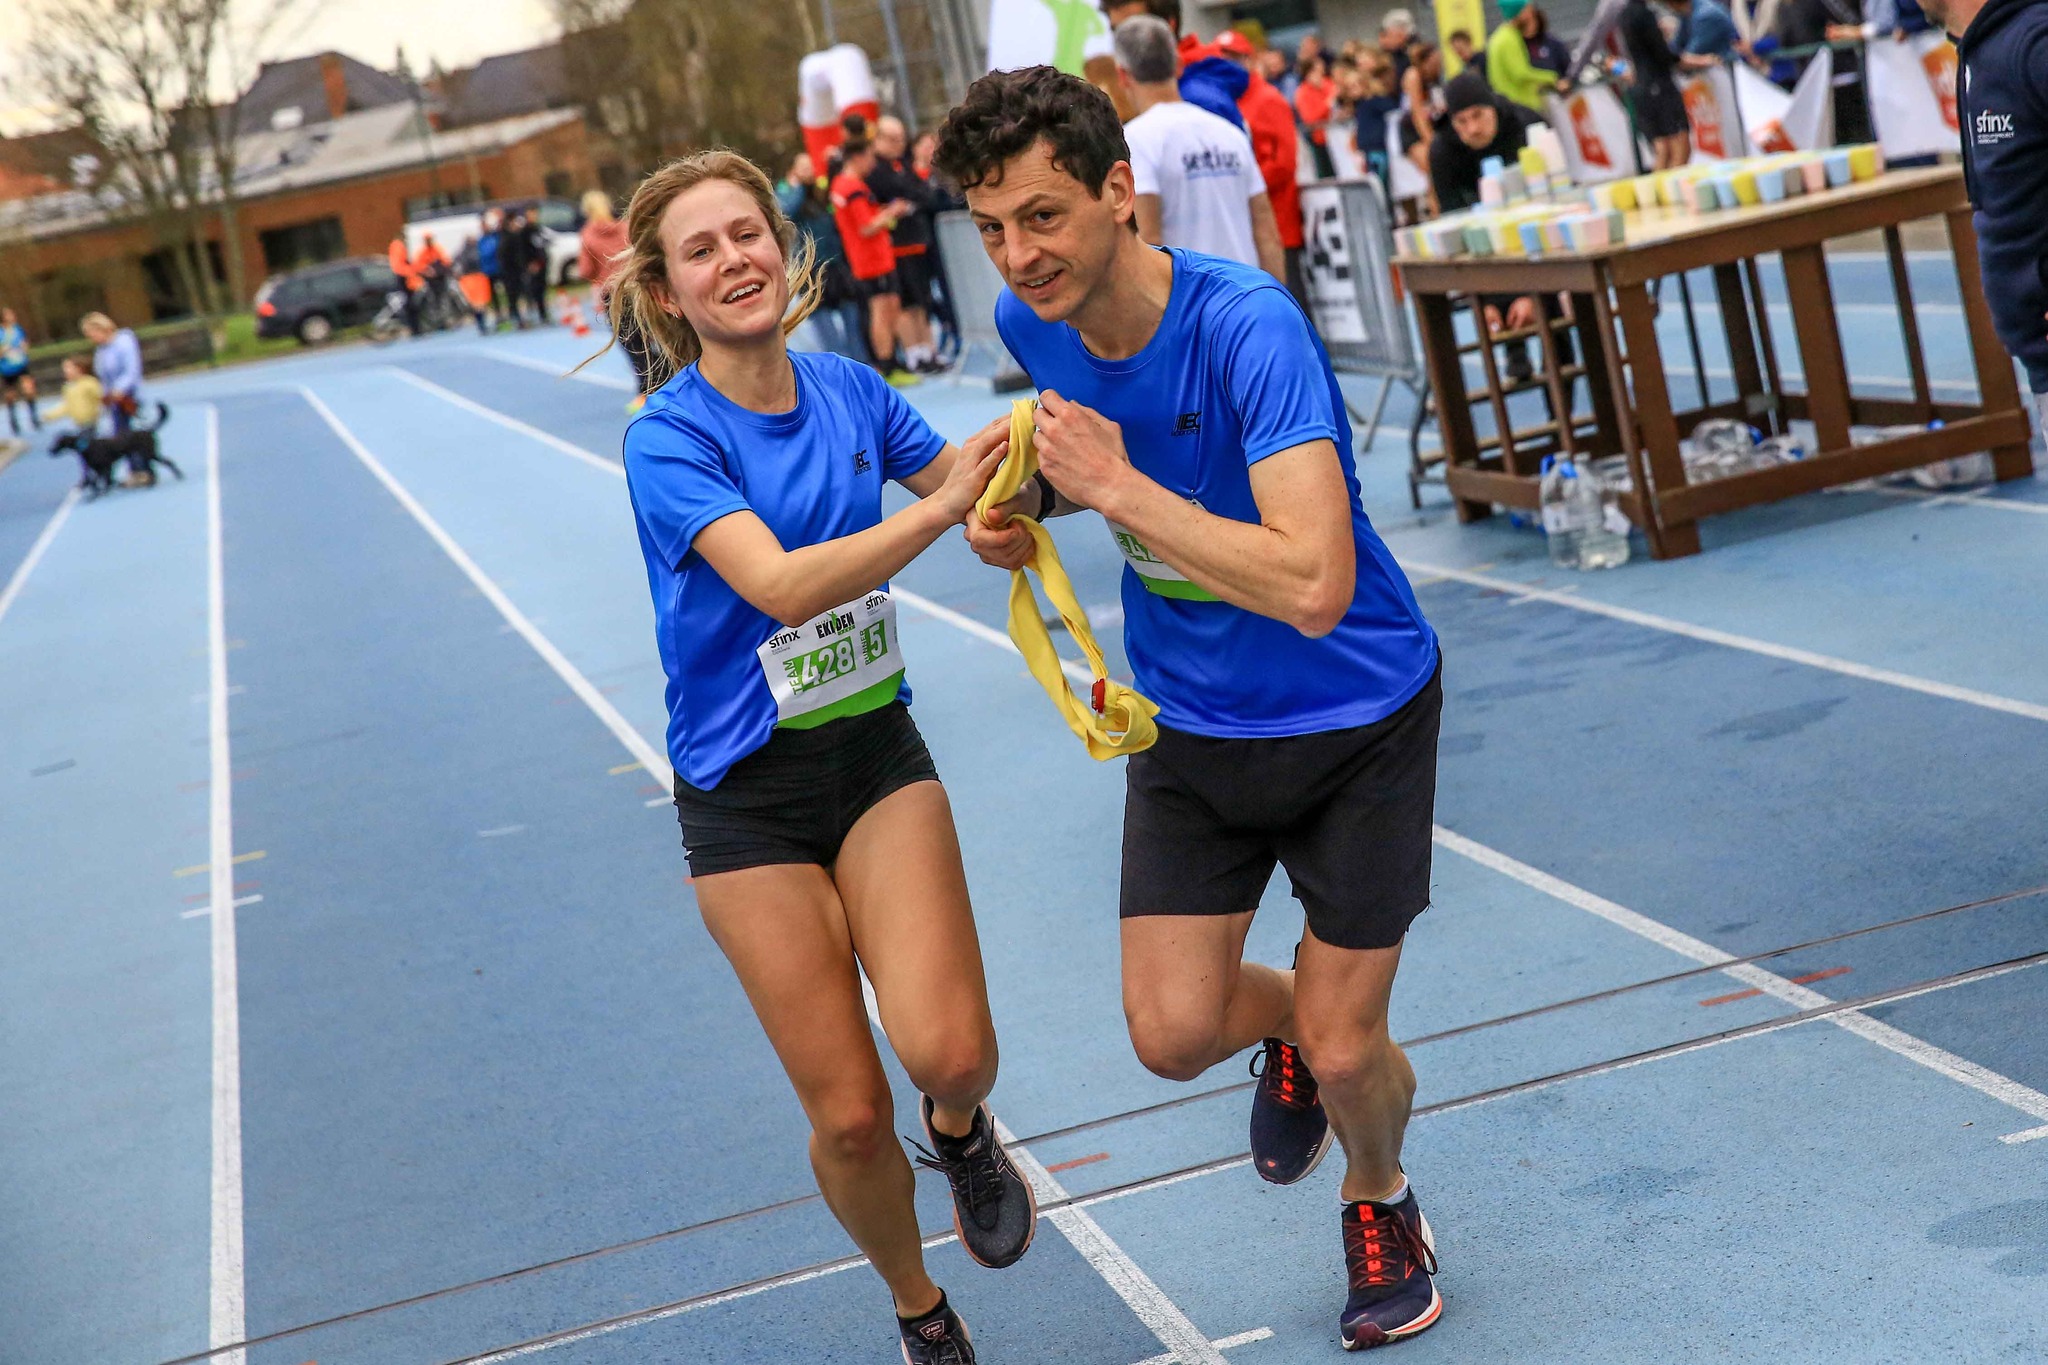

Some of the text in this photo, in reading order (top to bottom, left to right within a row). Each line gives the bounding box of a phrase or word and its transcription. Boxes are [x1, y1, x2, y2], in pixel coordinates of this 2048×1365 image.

[1976, 109, 2014, 133] sfinx
[866, 593, 887, 610] sfinx
[815, 611, 855, 638] EKIDEN
[768, 630, 800, 648] sfinx
[859, 623, 883, 665] RUNNER 5
[783, 640, 853, 695] TEAM 428
